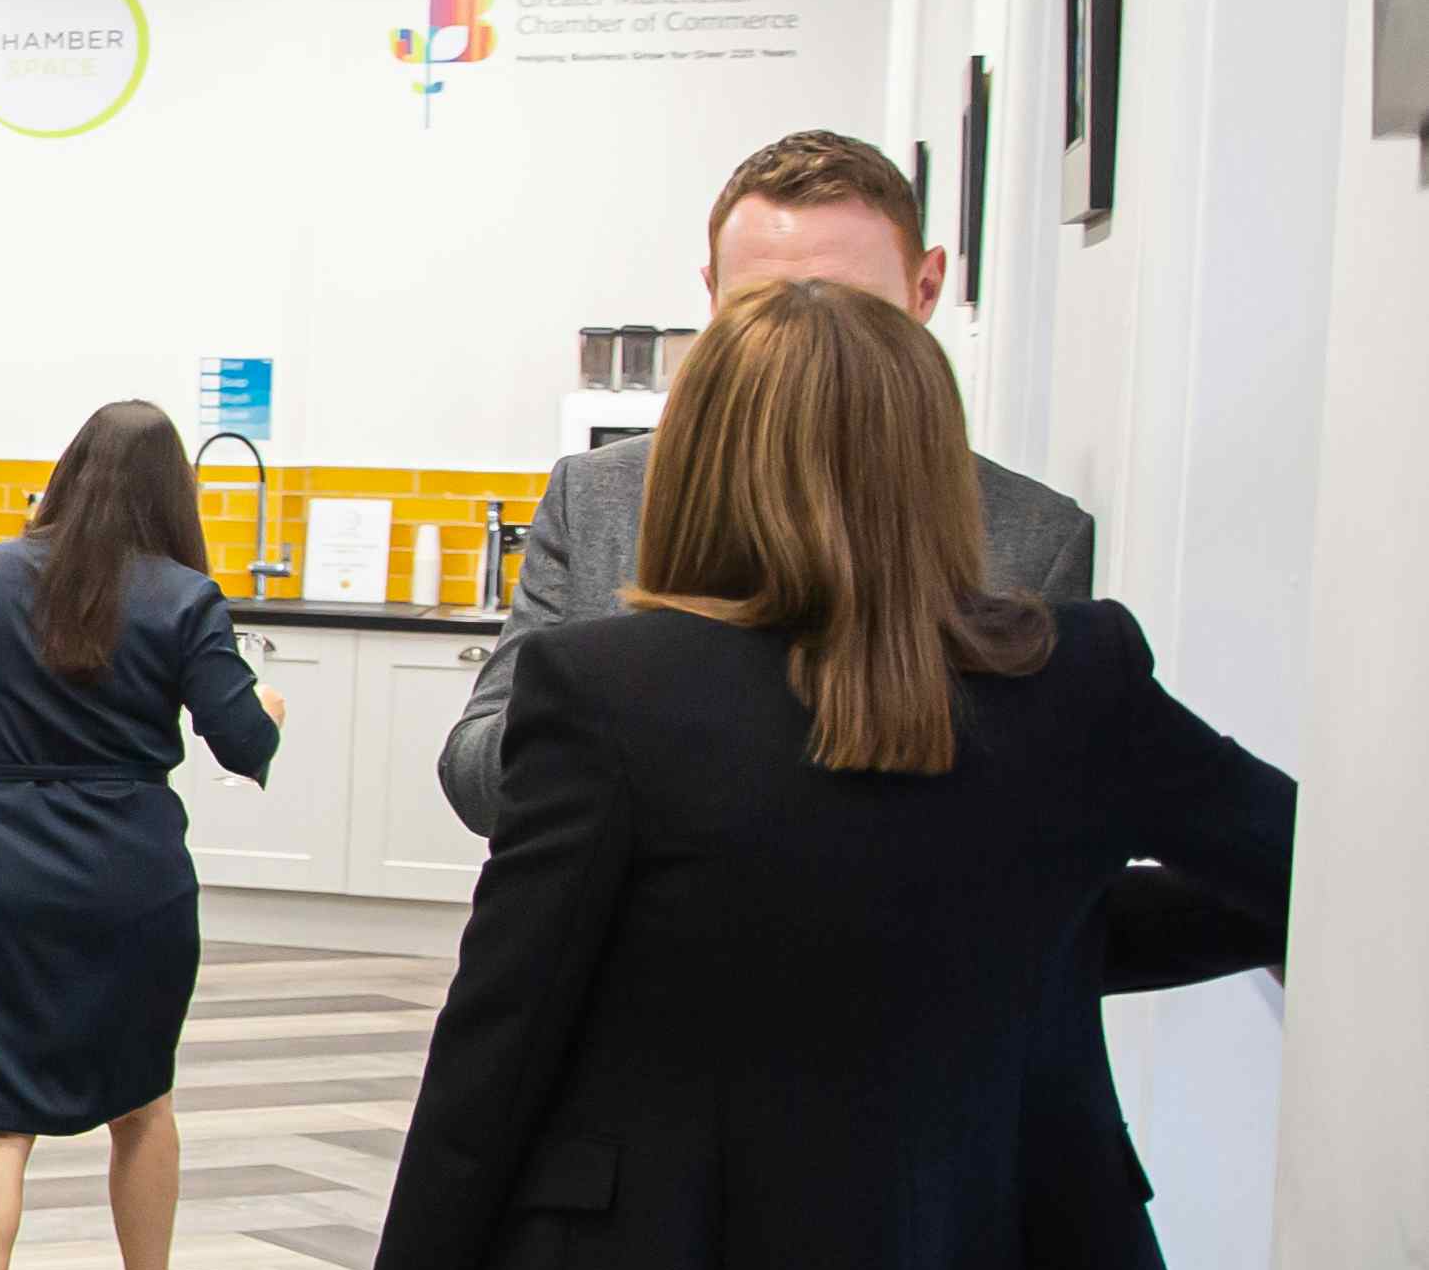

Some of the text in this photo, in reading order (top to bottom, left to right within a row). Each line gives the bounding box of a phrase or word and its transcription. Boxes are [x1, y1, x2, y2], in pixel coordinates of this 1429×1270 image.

[516, 11, 800, 35] Chamber of Commerce
[6, 57, 100, 77] SPACE
